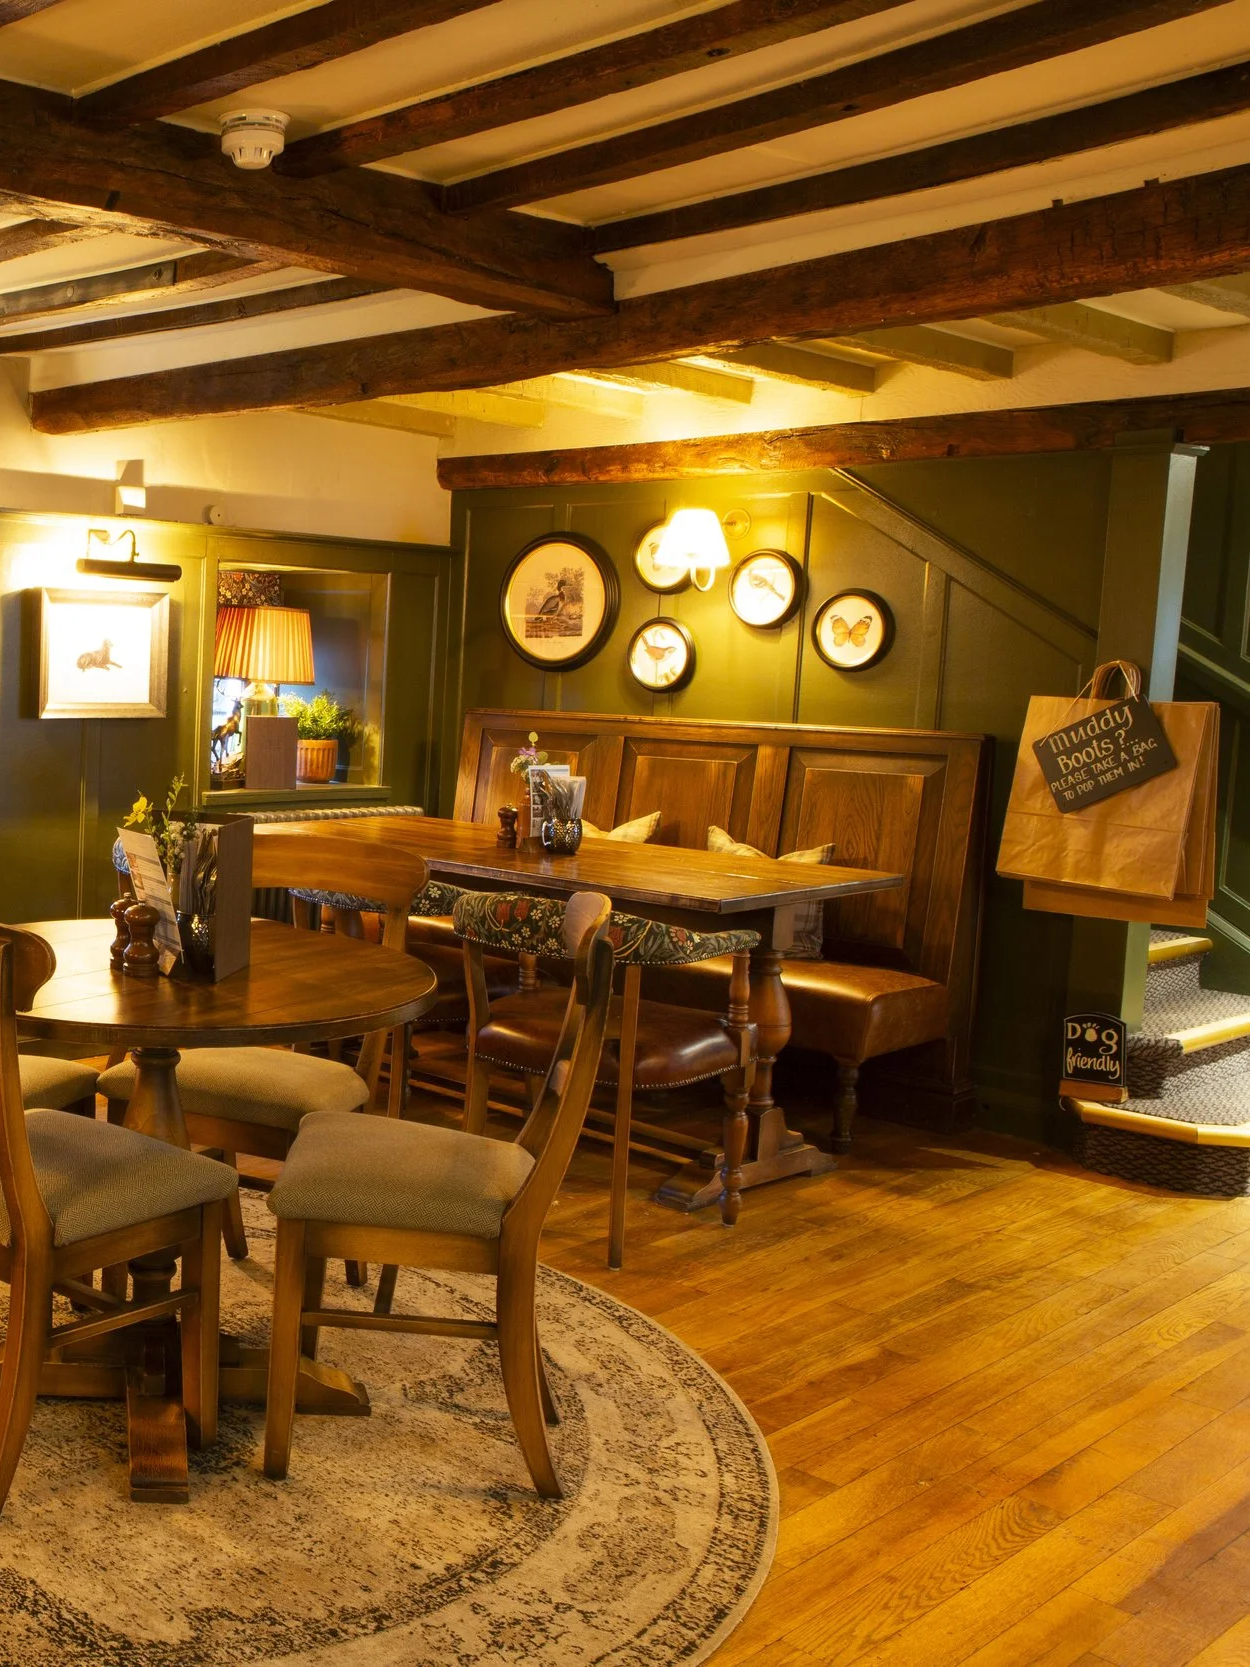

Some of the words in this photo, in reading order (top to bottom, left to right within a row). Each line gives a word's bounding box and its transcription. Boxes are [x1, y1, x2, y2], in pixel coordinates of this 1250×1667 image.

[1050, 767, 1091, 793] PLEASE
[1091, 755, 1119, 775] TAKE
[1120, 751, 1130, 763] A
[1132, 738, 1158, 757] BAG
[1056, 738, 1114, 775] Boots
[1063, 789, 1076, 801] TO
[1076, 780, 1095, 796] POP
[1097, 767, 1124, 785] THEM
[1128, 756, 1146, 772] IN!
[1066, 1046, 1121, 1080] friendly
